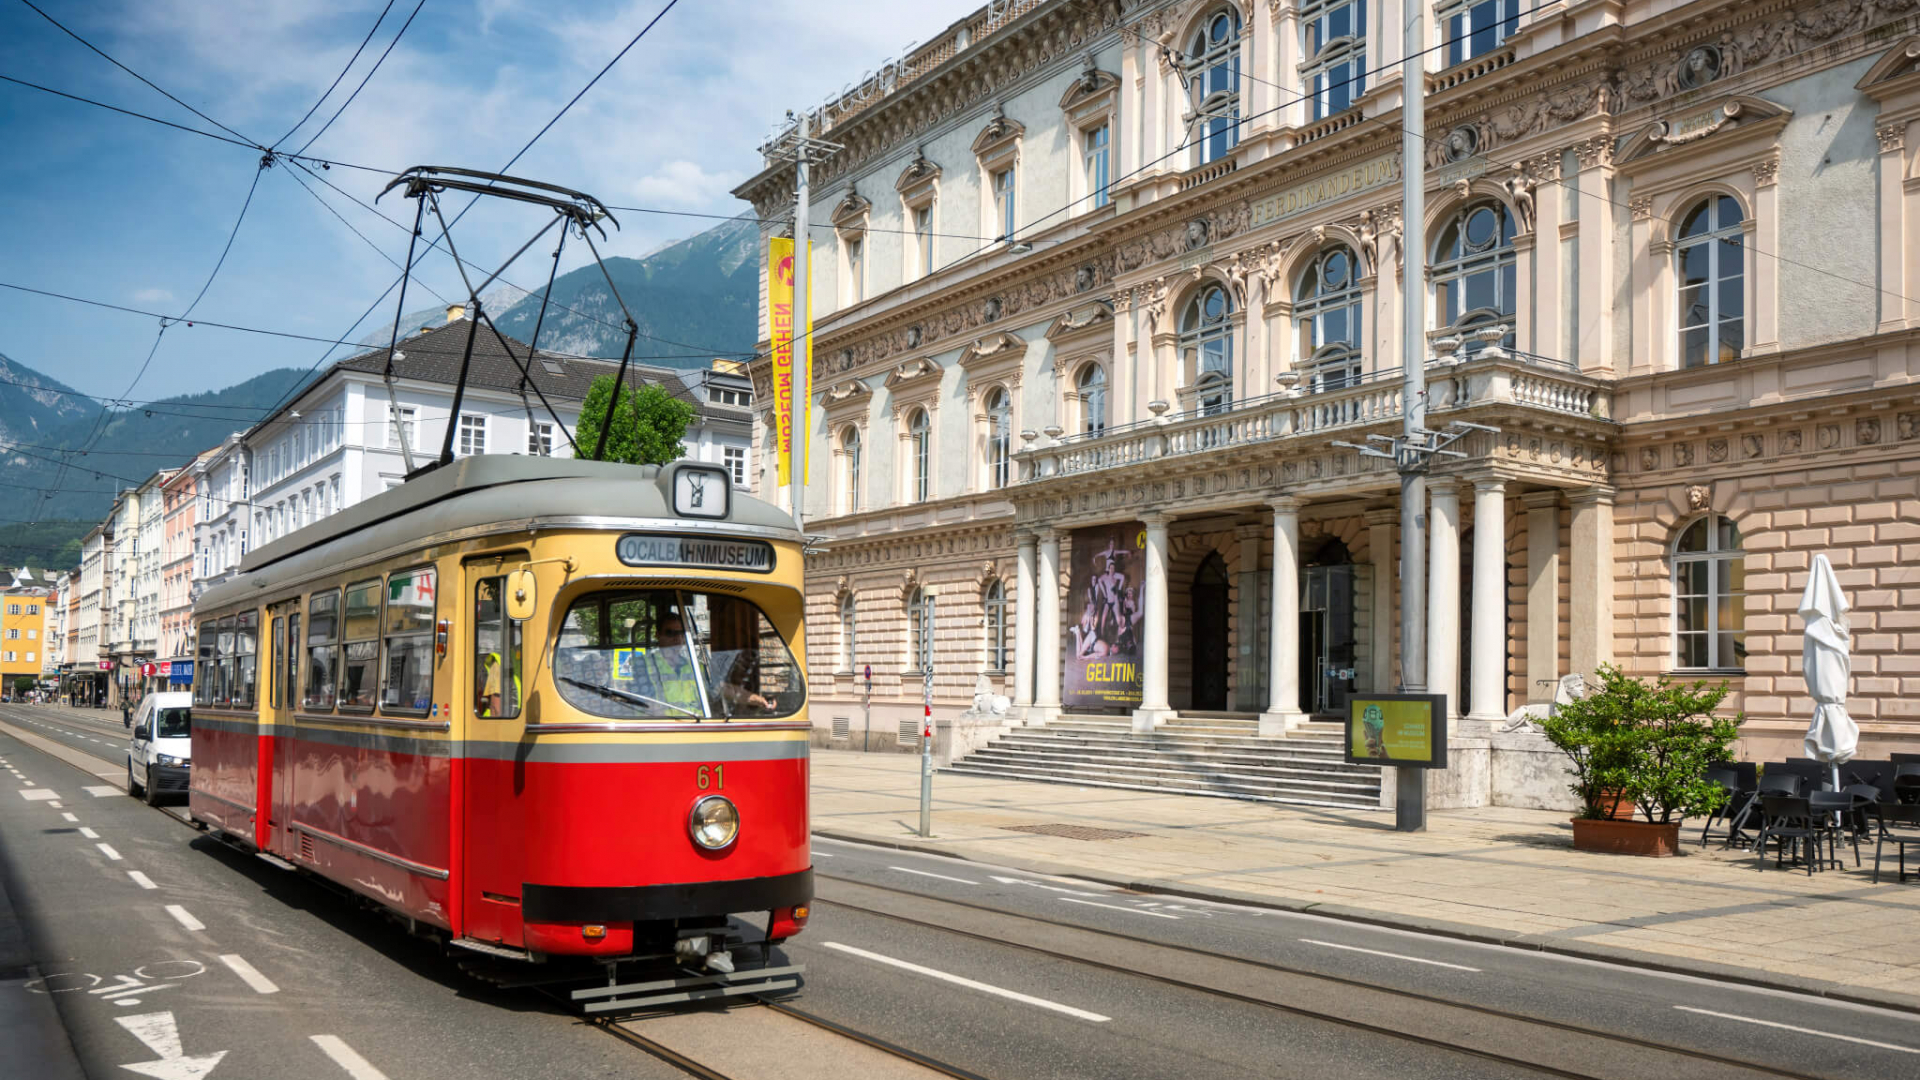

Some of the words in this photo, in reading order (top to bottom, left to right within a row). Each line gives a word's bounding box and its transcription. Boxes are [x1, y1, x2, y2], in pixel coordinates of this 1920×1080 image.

[1253, 158, 1392, 224] FERDINANDEUM
[621, 540, 766, 567] OCALBAHNMUSEUM
[1086, 662, 1135, 682] GELITIN
[697, 763, 723, 790] 61
